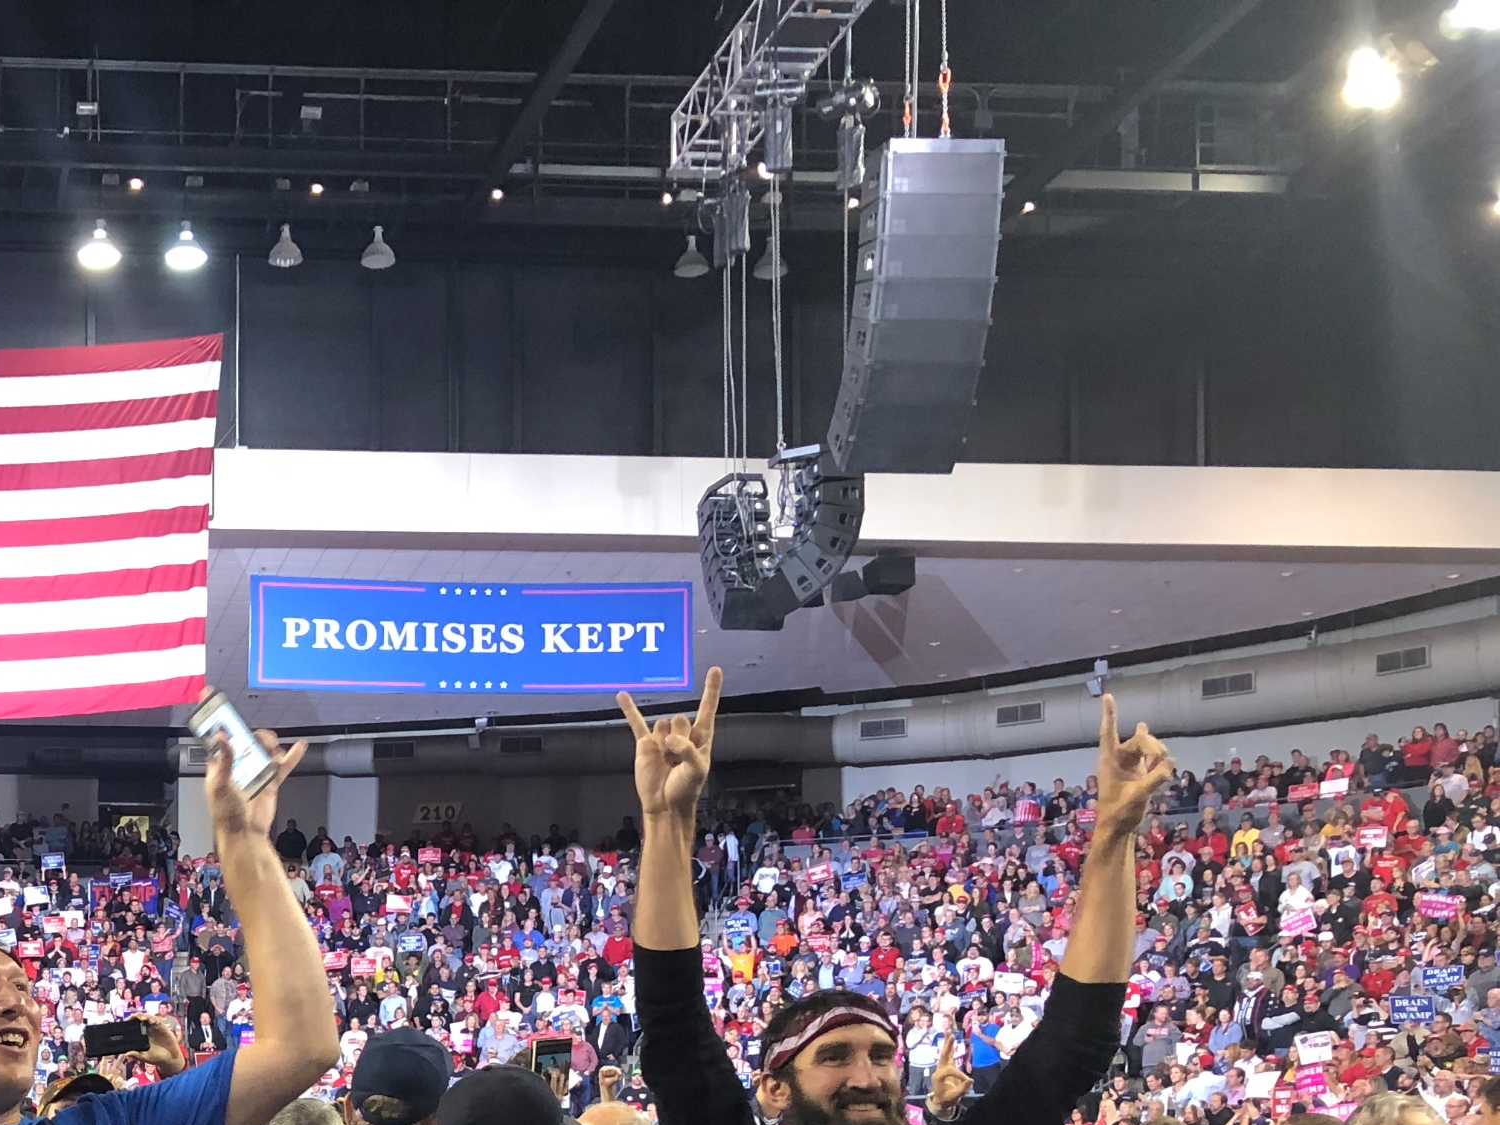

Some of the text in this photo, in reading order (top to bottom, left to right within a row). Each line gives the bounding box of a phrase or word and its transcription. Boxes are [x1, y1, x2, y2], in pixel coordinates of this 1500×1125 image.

[281, 617, 666, 655] PROMISES KEPT
[420, 805, 455, 820] 210
[1426, 967, 1459, 976] DRAIN
[1423, 975, 1460, 985] SWAMP
[1394, 998, 1429, 1007] DRAIN
[1393, 1011, 1432, 1020] SWAMP
